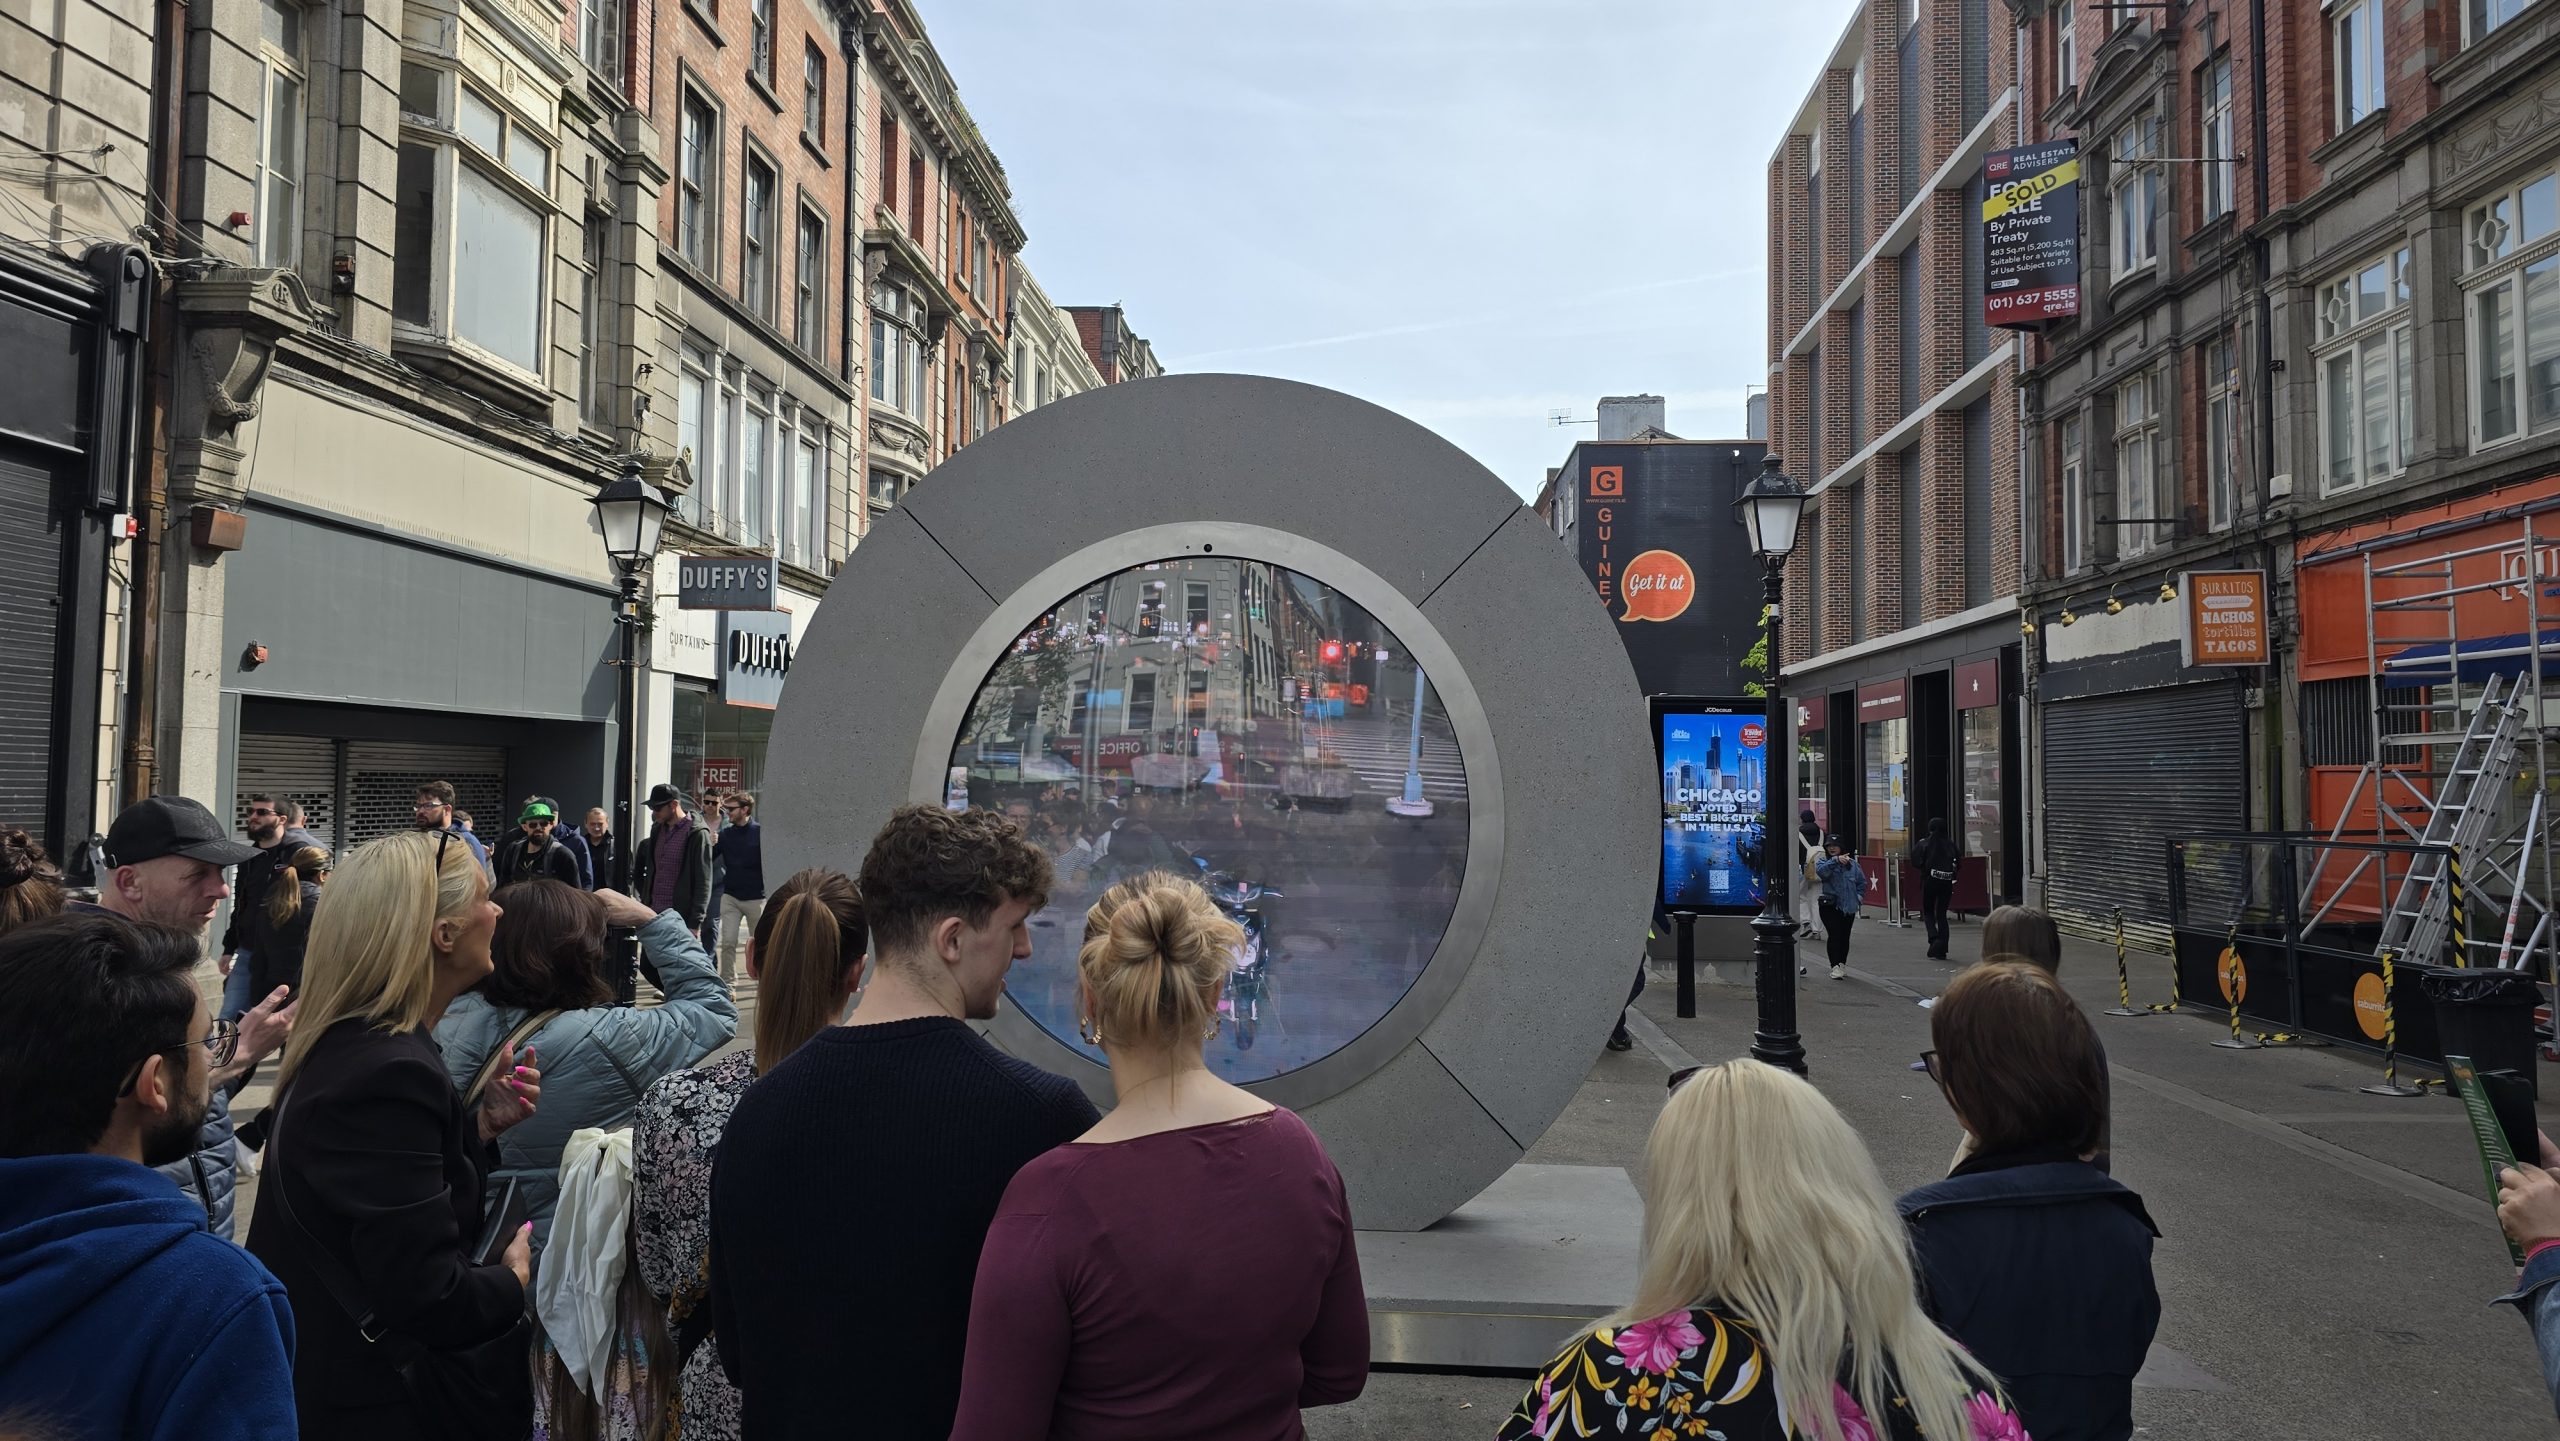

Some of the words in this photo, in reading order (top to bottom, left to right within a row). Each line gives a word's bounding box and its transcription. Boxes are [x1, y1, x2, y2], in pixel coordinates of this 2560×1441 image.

[2013, 154, 2037, 163] REAL
[2041, 147, 2076, 159] ESTATE
[1988, 161, 2009, 172] QRE
[2013, 158, 2059, 171] ADVISERS
[1990, 179, 2031, 199] FO
[2005, 174, 2057, 207] SOLD
[1990, 222, 2005, 234] By
[2009, 215, 2052, 230] Private
[1990, 231, 2029, 244] Treaty
[1990, 248, 2005, 256] 483
[2006, 246, 2026, 256] Sq.m
[2052, 238, 2075, 248] Sq.ft)
[1990, 256, 2021, 266] Suitable
[2023, 253, 2034, 261] for
[2042, 249, 2070, 260] Variety
[1990, 268, 1999, 276] of
[2000, 266, 2015, 274] Use
[2016, 262, 2045, 273] Subject
[2046, 260, 2056, 268] to
[2057, 258, 2073, 266] P.P.
[1989, 297, 2013, 311] (01)
[2016, 293, 2040, 305] 637
[2044, 288, 2077, 302] 5555
[2043, 301, 2076, 313] qre.ie
[1596, 470, 1617, 492] G
[682, 565, 769, 590] DUFFY'S
[1629, 574, 1653, 597] Get
[1655, 574, 1667, 590] it
[1669, 574, 1685, 590] at
[2201, 581, 2254, 595] BURRITOS
[2201, 610, 2256, 624] NACHOS
[2202, 624, 2257, 638] tortillas
[669, 631, 705, 651] CURTAINS
[2204, 640, 2257, 653] TACOS
[700, 768, 739, 783] FREE
[1675, 788, 1762, 803] CHICAGO
[1700, 803, 1737, 813] VOTED
[1680, 813, 1708, 822] BEST
[1710, 813, 1729, 823] BIG
[1731, 813, 1757, 823] CITY
[1685, 822, 1697, 831] IN
[1699, 823, 1721, 832] THE
[2357, 999, 2386, 1013] saburrito
